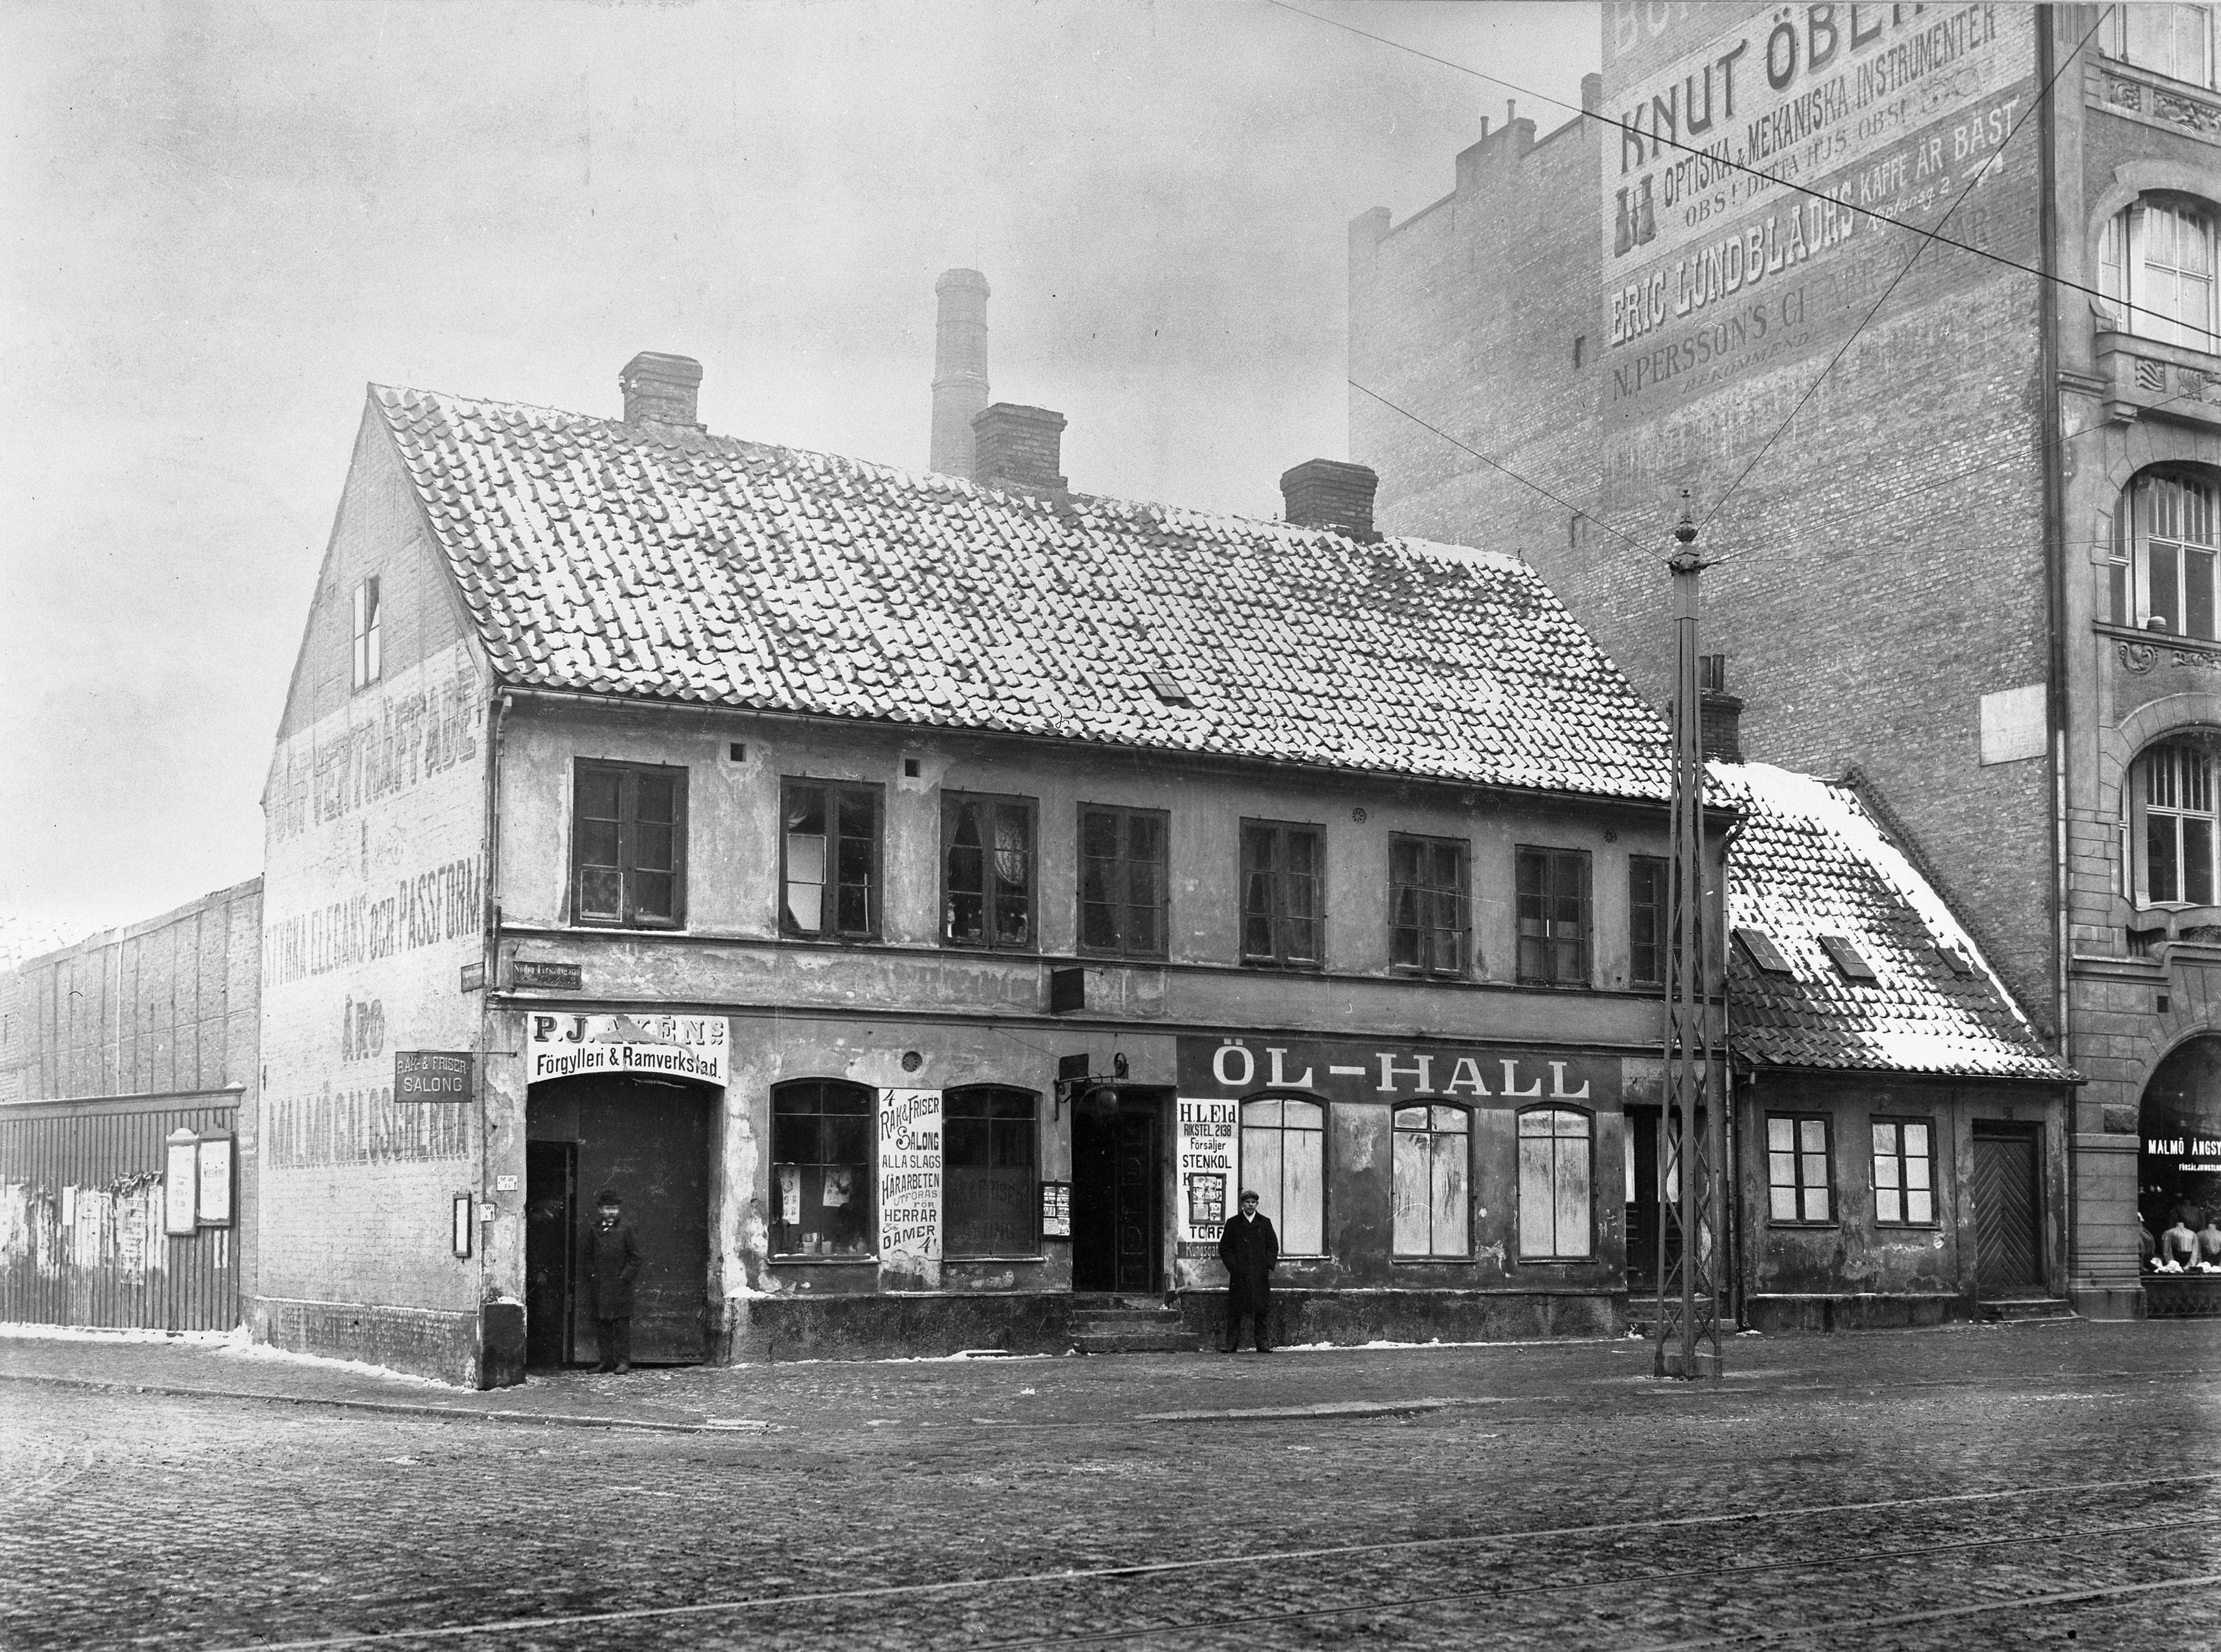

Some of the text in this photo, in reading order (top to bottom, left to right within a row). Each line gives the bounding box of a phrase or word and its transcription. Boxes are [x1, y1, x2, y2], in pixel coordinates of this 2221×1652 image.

[1621, 38, 1748, 175] KNUT
[1664, 137, 1733, 208] OPTISKA
[1748, 74, 1849, 166] MEKANISKA
[1857, 4, 1996, 108] INSTRUMENTER
[1747, 155, 1799, 198] DETTA
[1940, 176, 1950, 194] 2
[1611, 270, 1666, 348] ERIC
[1676, 179, 1854, 319] LUNDBLADHS
[1860, 154, 1908, 206] KAFFE
[1916, 137, 1943, 179] ÄR
[370, 897, 394, 960] OCH
[399, 854, 481, 953] PASSFORM
[422, 1056, 428, 1070] &
[537, 1048, 604, 1075] Förgylleri
[609, 1048, 620, 1066] &
[404, 1077, 462, 1092] SALONG
[896, 1126, 939, 1150] SALONG
[1216, 1124, 1232, 1137] 2138
[1190, 1138, 1226, 1153] Försäljer
[2148, 1137, 2184, 1155] MALMÖ
[882, 1155, 940, 1168] ALLA SLAGS
[1183, 1154, 1232, 1169] STENKOL
[882, 1173, 939, 1206] HÅRARBETEN
[914, 1200, 934, 1208] FÖR
[885, 1209, 937, 1223] HERRAR
[883, 1225, 935, 1250] DAMER
